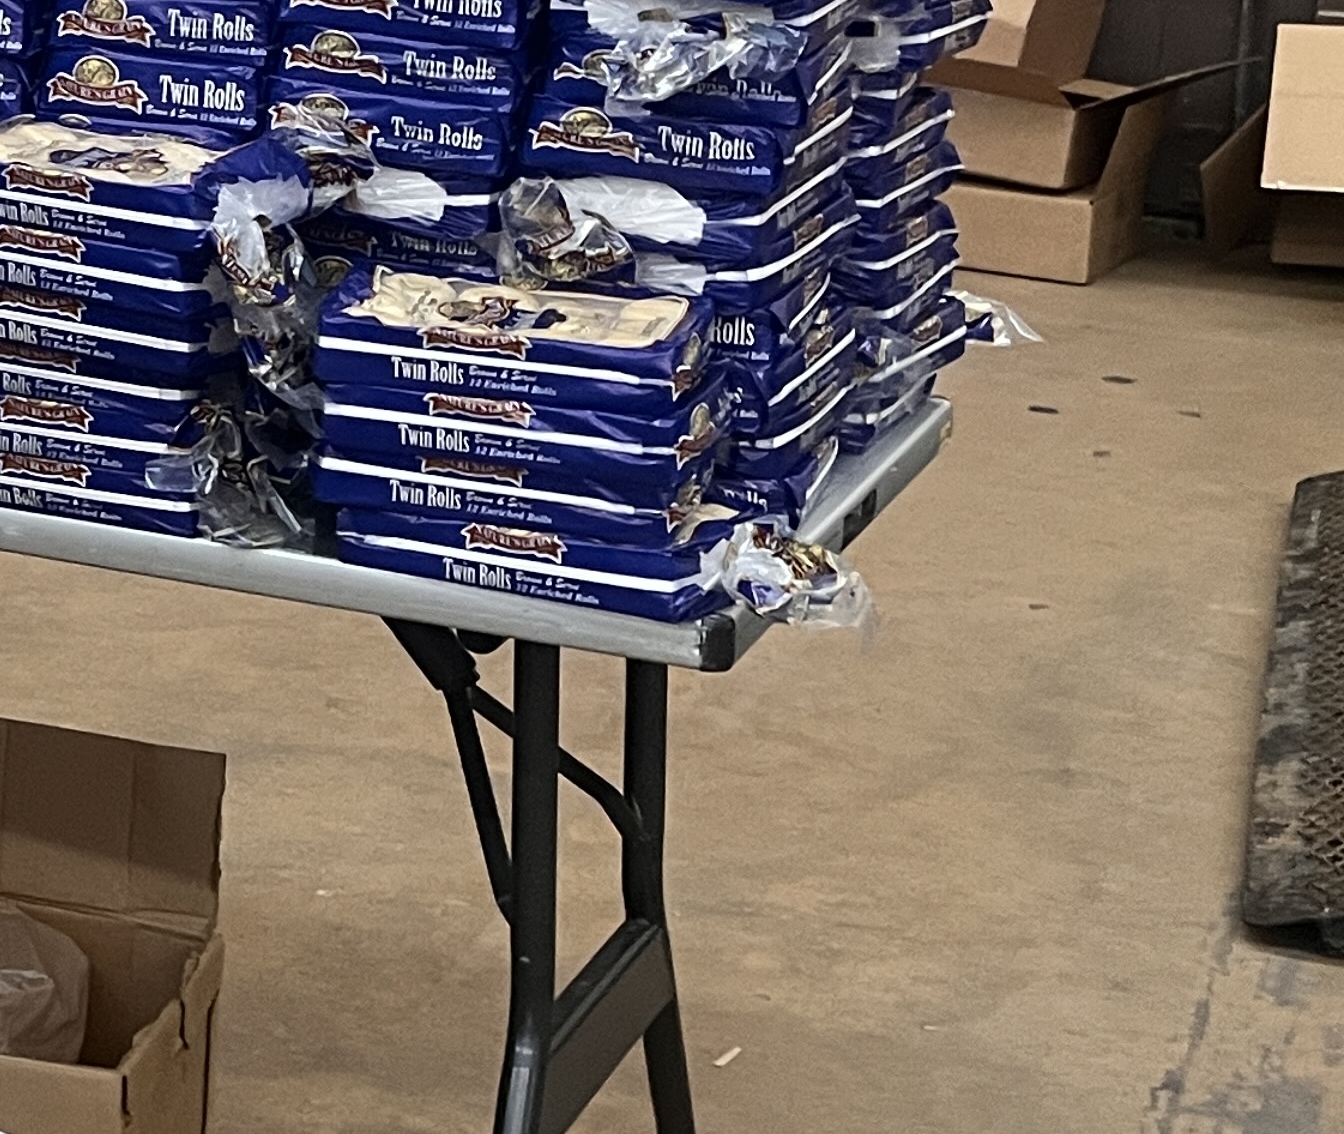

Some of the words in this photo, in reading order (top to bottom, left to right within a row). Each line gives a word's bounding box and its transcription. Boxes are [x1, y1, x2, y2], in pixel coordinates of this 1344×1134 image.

[168, 8, 208, 40] Twin
[213, 13, 255, 42] Rolls
[403, 50, 447, 79] Twin
[451, 57, 497, 82] Rolls
[159, 75, 199, 106] Twin
[203, 80, 246, 112] Rolls
[391, 116, 433, 143] Twin
[439, 122, 483, 151] Rolls
[658, 125, 703, 159] Twin
[709, 131, 756, 161] Rolls
[20, 202, 49, 226] Rolls
[7, 261, 36, 287] Rolls
[8, 320, 38, 345] Rolls
[2, 372, 32, 396] Rolls
[391, 356, 426, 382] Twin
[430, 358, 465, 386] Rolls
[13, 432, 43, 456] Rolls
[398, 423, 433, 449] Twin
[436, 428, 470, 453] Rolls
[389, 479, 424, 505] Twin
[427, 484, 462, 511] Rolls
[442, 557, 477, 583] Twin
[479, 562, 512, 591] Rolls
